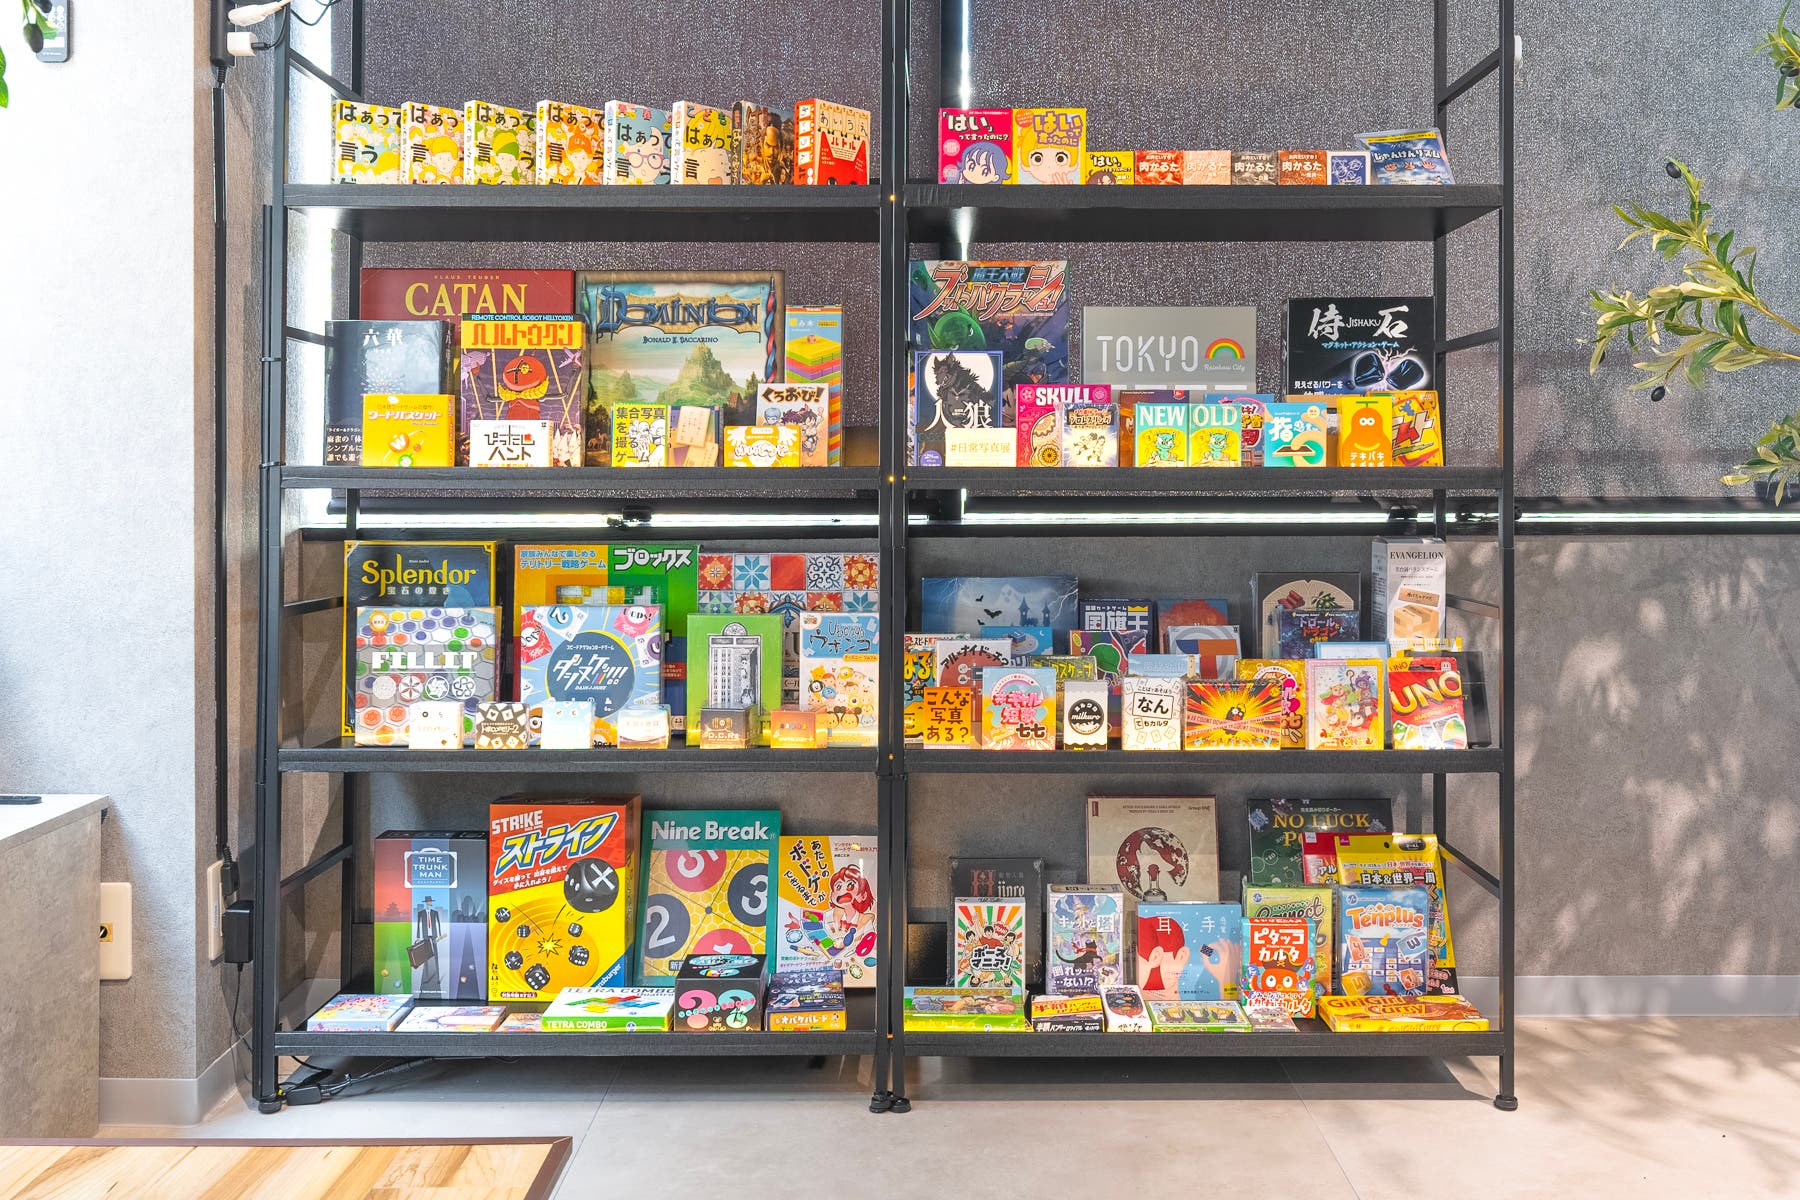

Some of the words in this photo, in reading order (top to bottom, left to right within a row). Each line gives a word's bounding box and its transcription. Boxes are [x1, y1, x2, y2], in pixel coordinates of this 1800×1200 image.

[1032, 110, 1084, 134] はい
[958, 133, 1009, 142] って言ったのに?
[1038, 135, 1079, 146] 言ったのに
[1373, 149, 1441, 163] じゃんけんリズム
[1139, 161, 1180, 172] 肉かるた
[1234, 162, 1275, 172] 肉かるた
[1282, 161, 1323, 172] 肉かるた
[405, 282, 528, 315] CATAN
[1307, 303, 1345, 341] 侍
[1346, 316, 1381, 328] JISHAKU
[1372, 304, 1410, 338] 石
[362, 328, 404, 347] 六華
[1096, 335, 1199, 373] TOKYO
[1203, 363, 1232, 372] Rainbow
[1233, 363, 1246, 372] City
[1294, 380, 1344, 389] 見えざるパワーを
[761, 386, 826, 404] くろおび!
[1035, 386, 1093, 406] SKULL
[368, 410, 442, 421] ワードバスケット
[616, 406, 666, 420] 集合写真
[923, 399, 995, 432] 人狼
[1140, 406, 1186, 427] NEW
[1192, 404, 1238, 427] OLD
[616, 421, 628, 434] を
[488, 446, 532, 461] ハント
[950, 441, 1011, 453] #日常写真展
[1349, 451, 1385, 461] テキパキ
[520, 549, 597, 559] 家族みんなで楽しめる
[614, 547, 693, 572] ブロックス
[1390, 551, 1444, 560] EVANGELION
[520, 559, 607, 569] テリトリー戦略ゲーム
[361, 553, 477, 598] Splendor
[1299, 617, 1335, 627] トロール
[371, 650, 478, 670] FILLIT
[926, 690, 970, 707] こんな
[1390, 670, 1463, 715] UNO
[1137, 696, 1170, 715] なん
[930, 707, 963, 725] 写真
[926, 725, 970, 743] ある?
[1015, 723, 1047, 739] 七七
[1272, 813, 1305, 829] NO
[1311, 813, 1371, 829] LUCK
[651, 820, 702, 841] Nine
[704, 820, 769, 841] Break
[494, 811, 620, 879] ストライク
[412, 863, 448, 871] TRUNK
[788, 839, 821, 894] ボドゲ
[810, 840, 830, 878] あたしの
[1360, 871, 1437, 885] 日本&世界一周
[741, 874, 768, 916] 3
[1156, 916, 1216, 935] 耳と手
[1345, 905, 1424, 930] Tenplus
[645, 905, 676, 950] 2
[1253, 926, 1305, 945] ピタッコ
[1258, 946, 1301, 962] カルタ
[971, 956, 1013, 970] マニア!
[1367, 1004, 1426, 1015] Curry
[546, 1020, 574, 1029] TETRA
[576, 1020, 608, 1029] COMBO
[780, 1014, 828, 1024] オバケパレード
